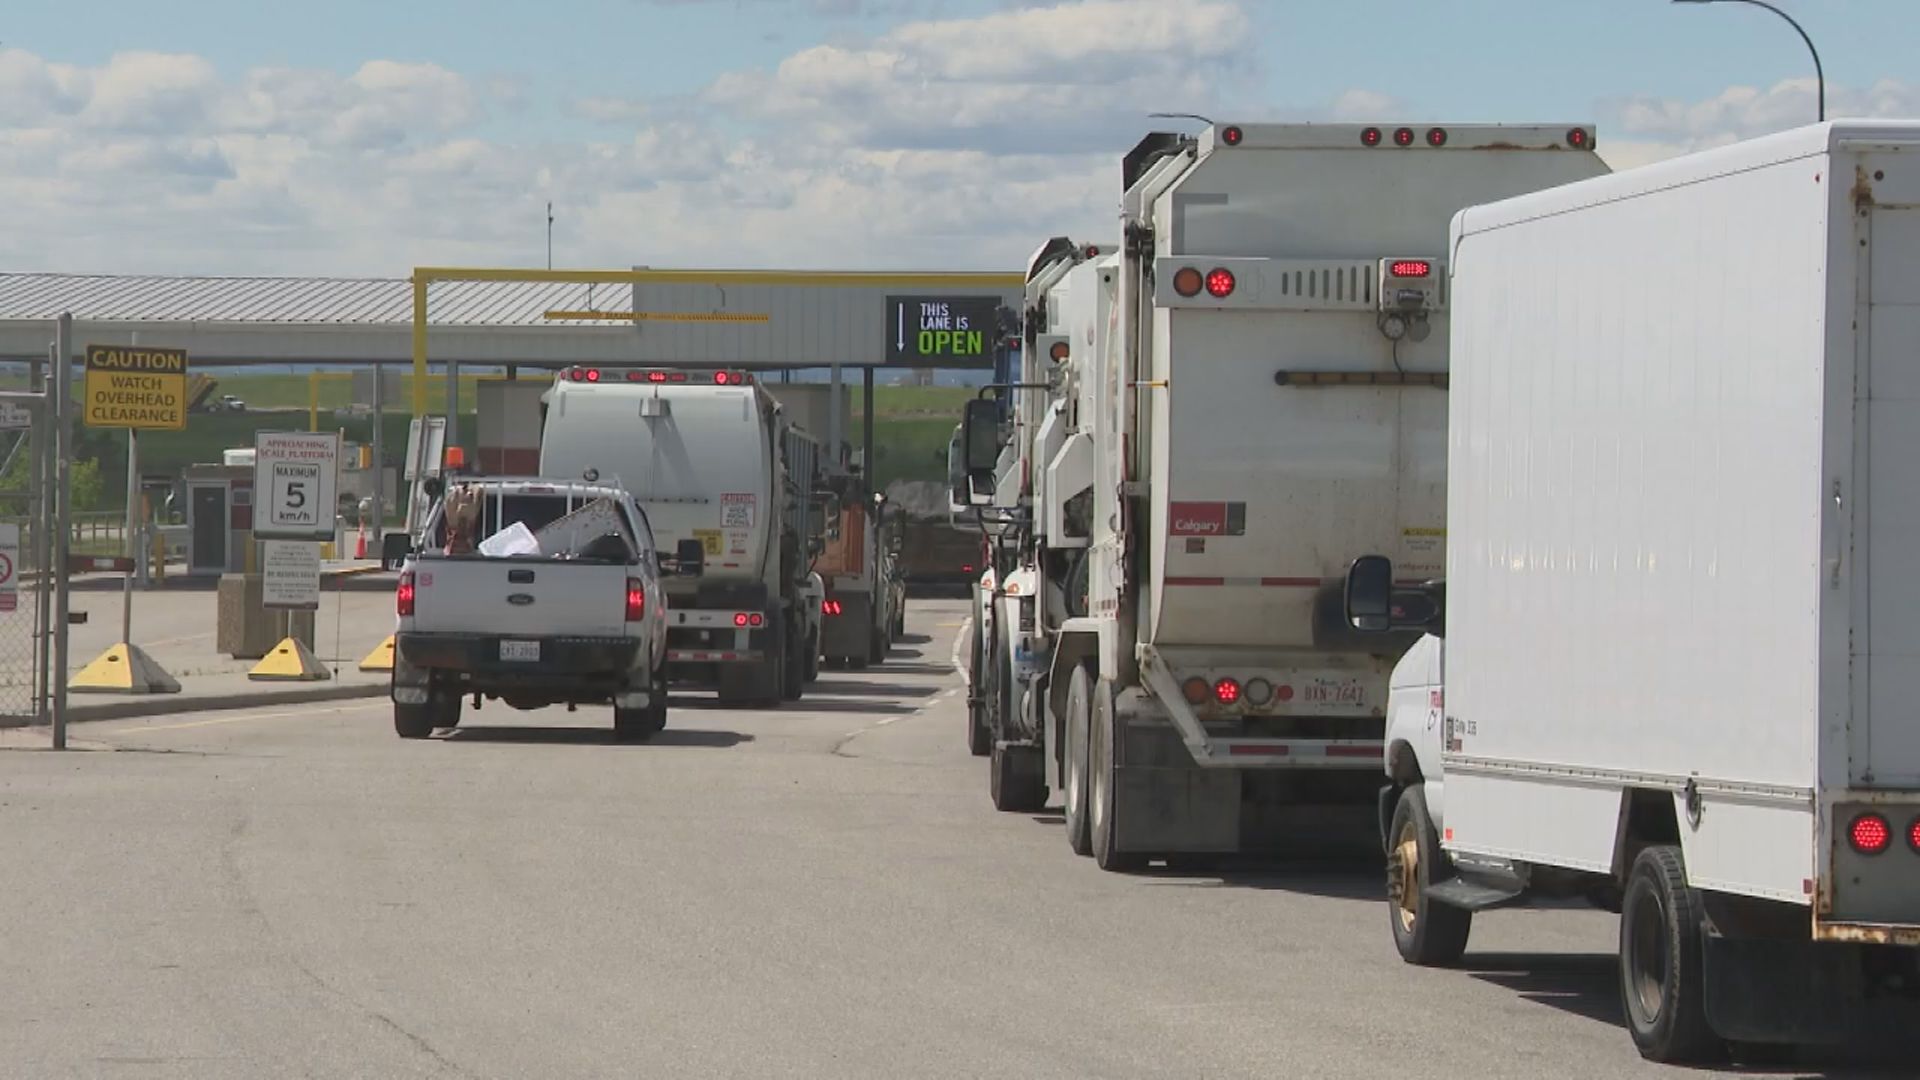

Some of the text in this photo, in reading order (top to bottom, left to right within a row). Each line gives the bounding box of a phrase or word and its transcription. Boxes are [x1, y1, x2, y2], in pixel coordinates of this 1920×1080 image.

[920, 303, 949, 316] THIS
[920, 317, 969, 330] LANE IS
[918, 331, 982, 355] OPEN
[92, 350, 181, 369] CAUTION
[111, 375, 163, 390] WATCH
[95, 390, 175, 407] OVERHEAD
[91, 407, 178, 423] CLEARANCE
[266, 439, 329, 450] APPROACHING
[260, 448, 334, 460] SCALE PLATFORM
[276, 466, 317, 477] MAXIMUM
[286, 482, 305, 508] 5
[279, 511, 310, 521] km/h
[1175, 519, 1220, 533] Calgary
